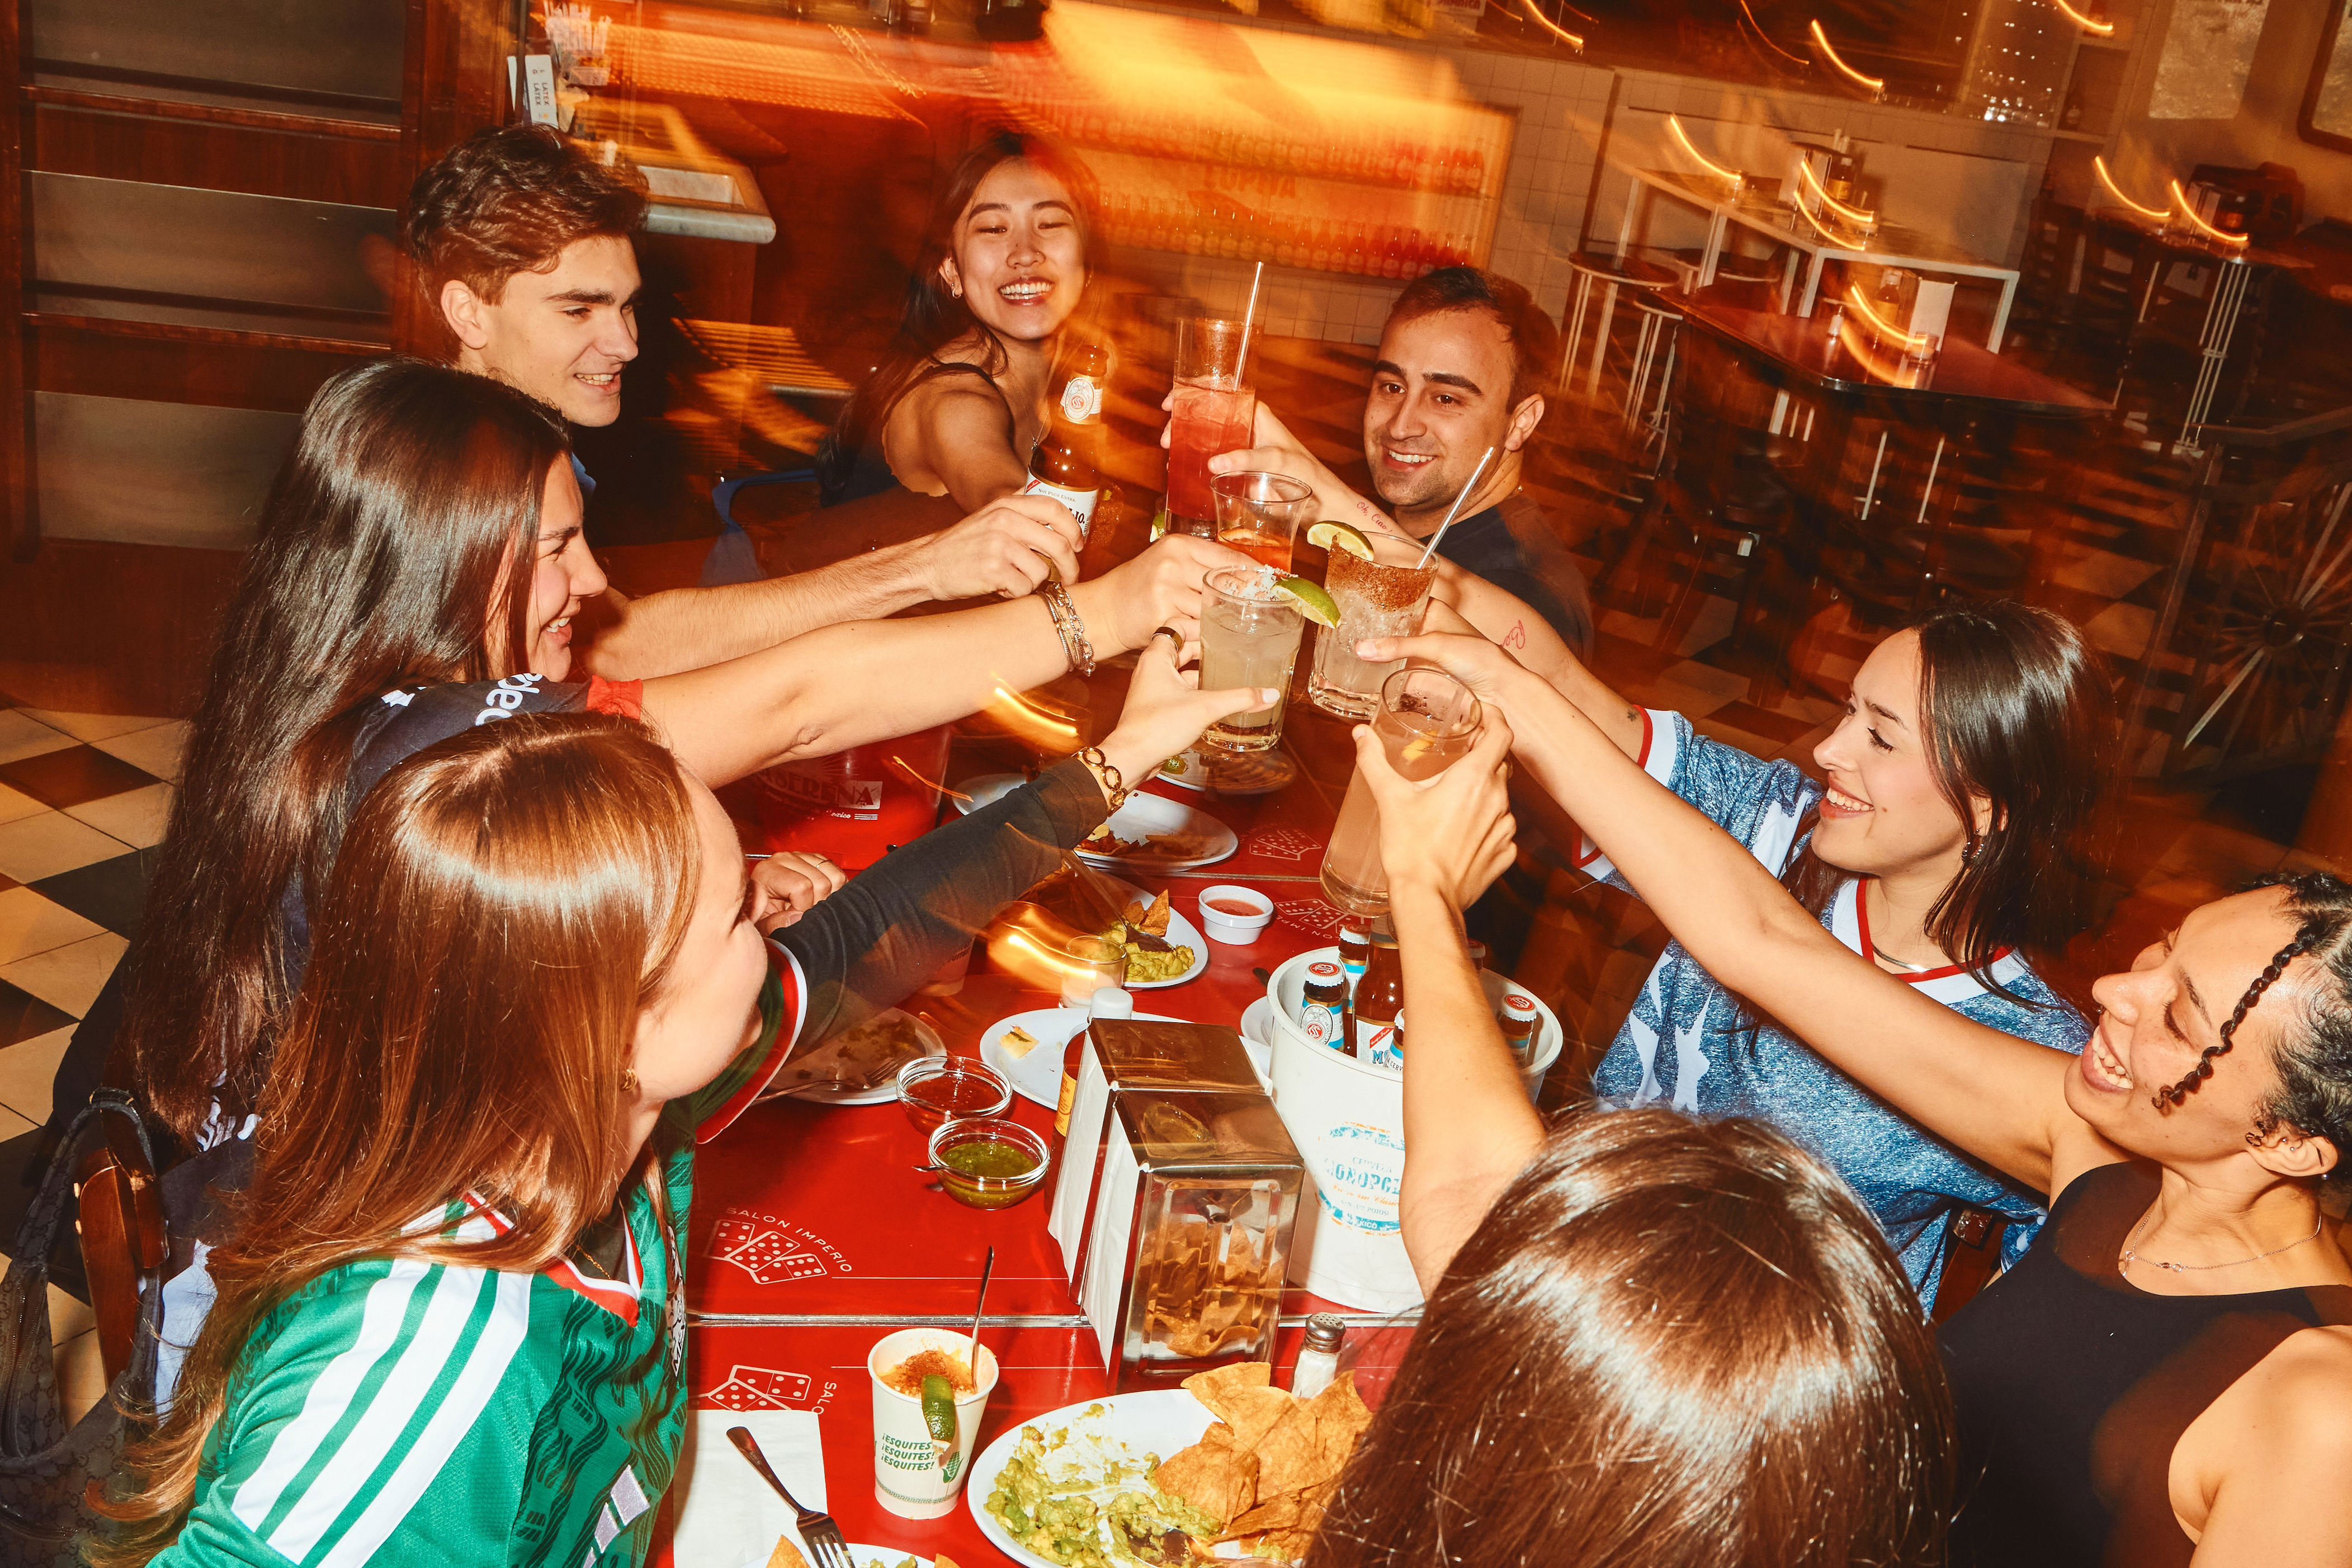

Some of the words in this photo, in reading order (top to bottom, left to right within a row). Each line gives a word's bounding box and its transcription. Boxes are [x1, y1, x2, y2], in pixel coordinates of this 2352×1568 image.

[541, 82, 550, 105] LATEX
[1390, 1060, 1404, 1071] CERV
[726, 1207, 791, 1229] SALON
[795, 1227, 853, 1273] IMPERIO
[811, 1381, 838, 1415] SALO
[882, 1433, 933, 1450] ¡ESQUITES
[882, 1443, 935, 1461] ¡ESQUITES!
[881, 1453, 935, 1471] ¡ESQUITES!
